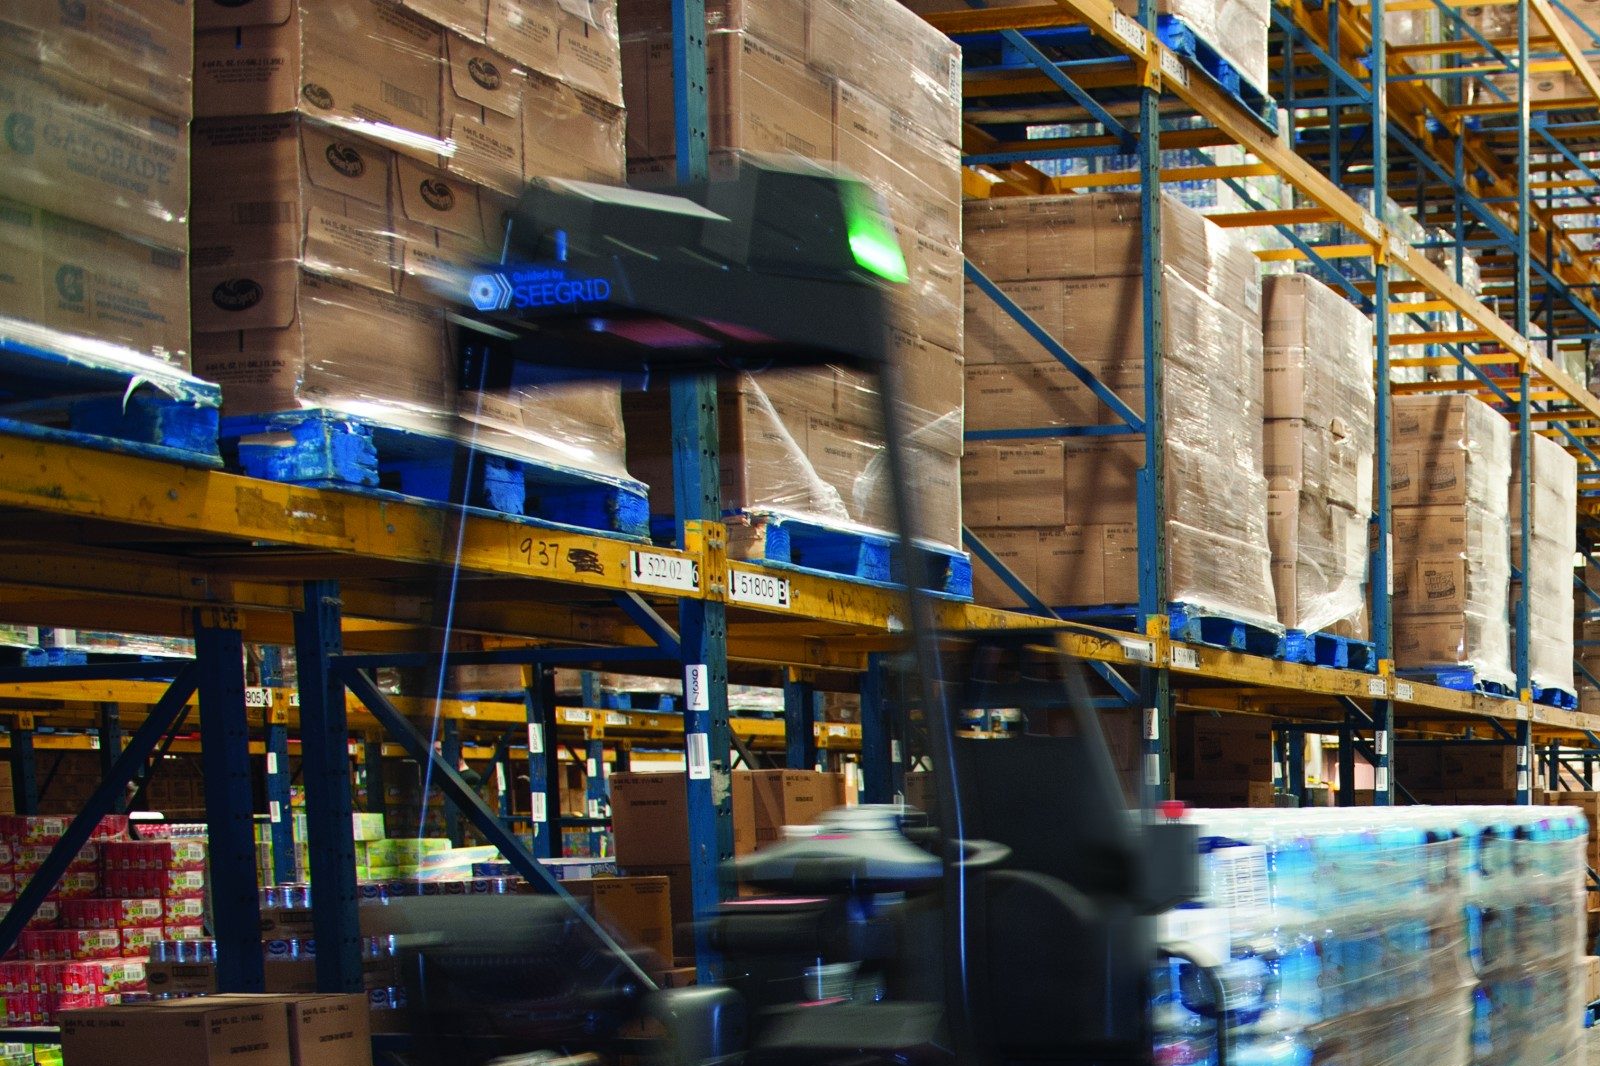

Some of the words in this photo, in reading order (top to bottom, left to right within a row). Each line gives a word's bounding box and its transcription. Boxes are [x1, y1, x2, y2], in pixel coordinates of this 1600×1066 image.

[552, 269, 564, 281] by
[514, 278, 611, 309] SEEGRID
[519, 537, 560, 568] 937
[741, 575, 774, 598] 51806
